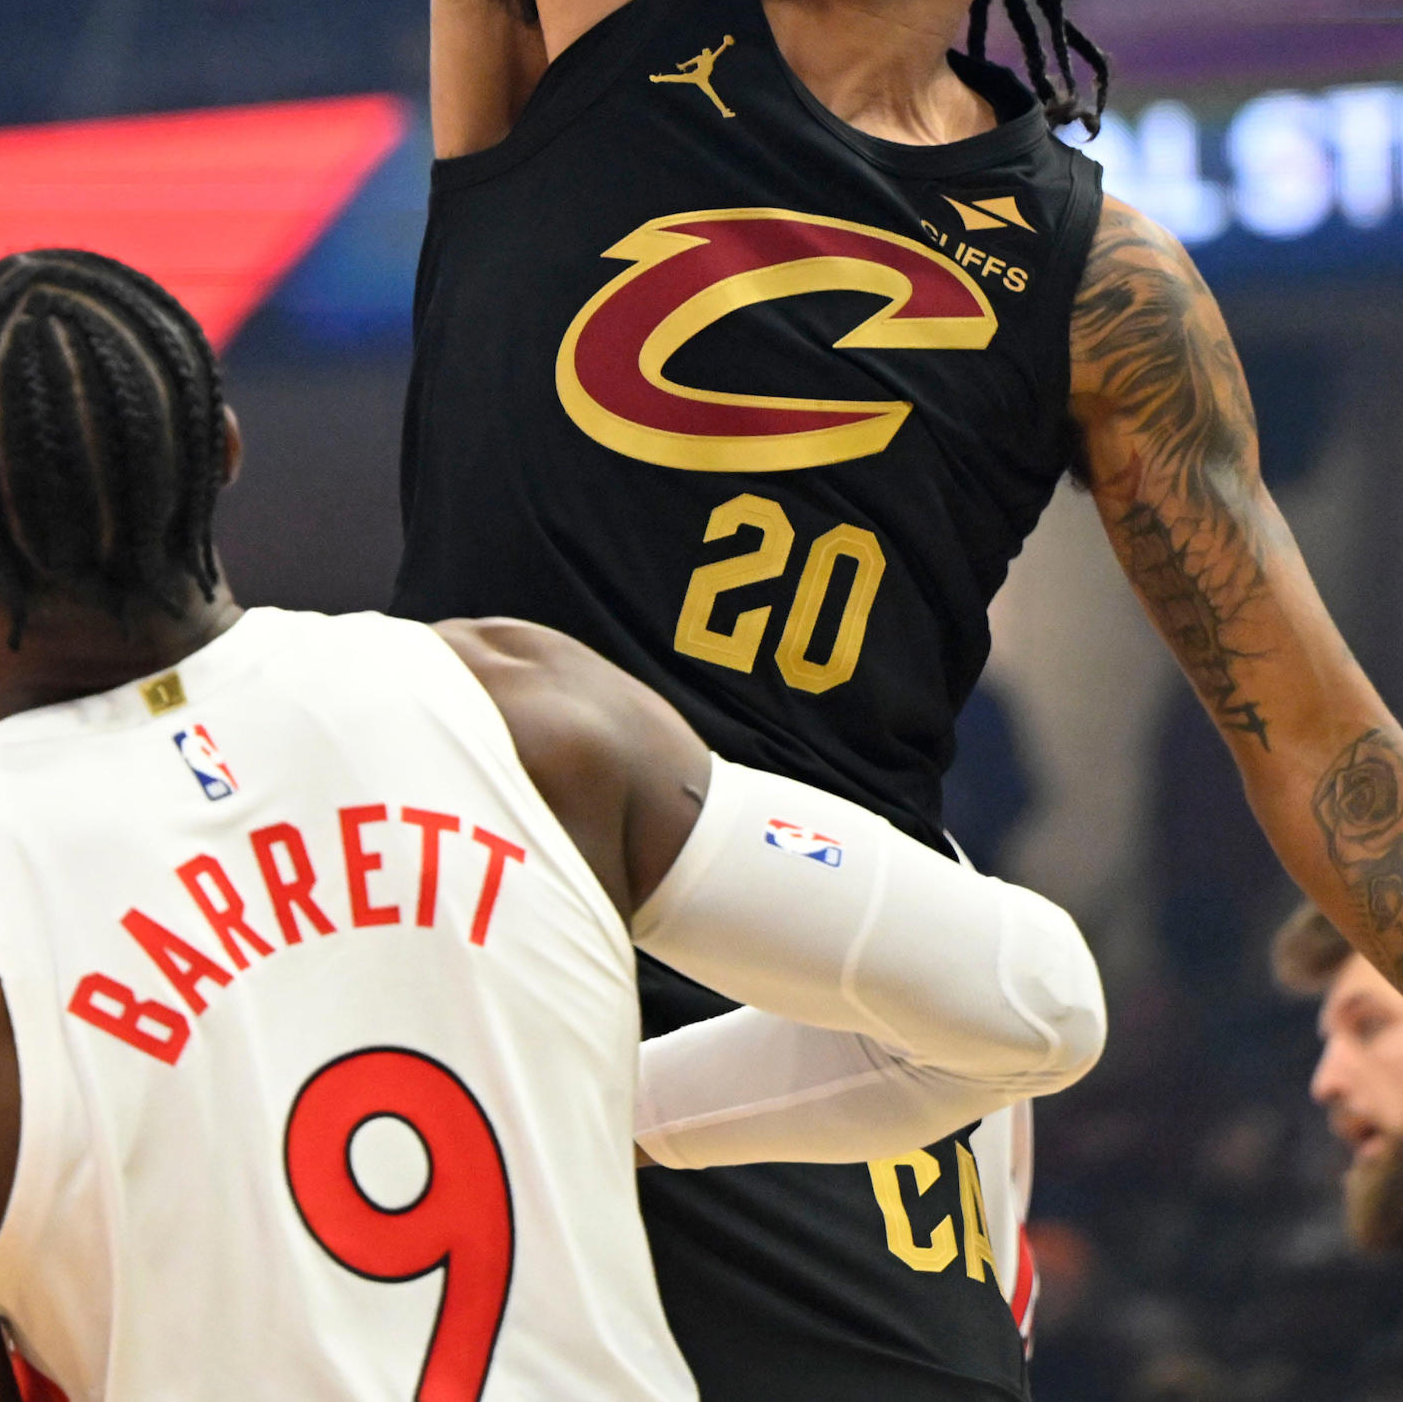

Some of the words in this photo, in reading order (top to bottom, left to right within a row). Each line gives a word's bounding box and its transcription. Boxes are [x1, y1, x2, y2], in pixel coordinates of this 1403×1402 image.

[673, 493, 886, 694] 20
[67, 803, 526, 1066] BARRETT
[283, 1044, 516, 1402] 9
